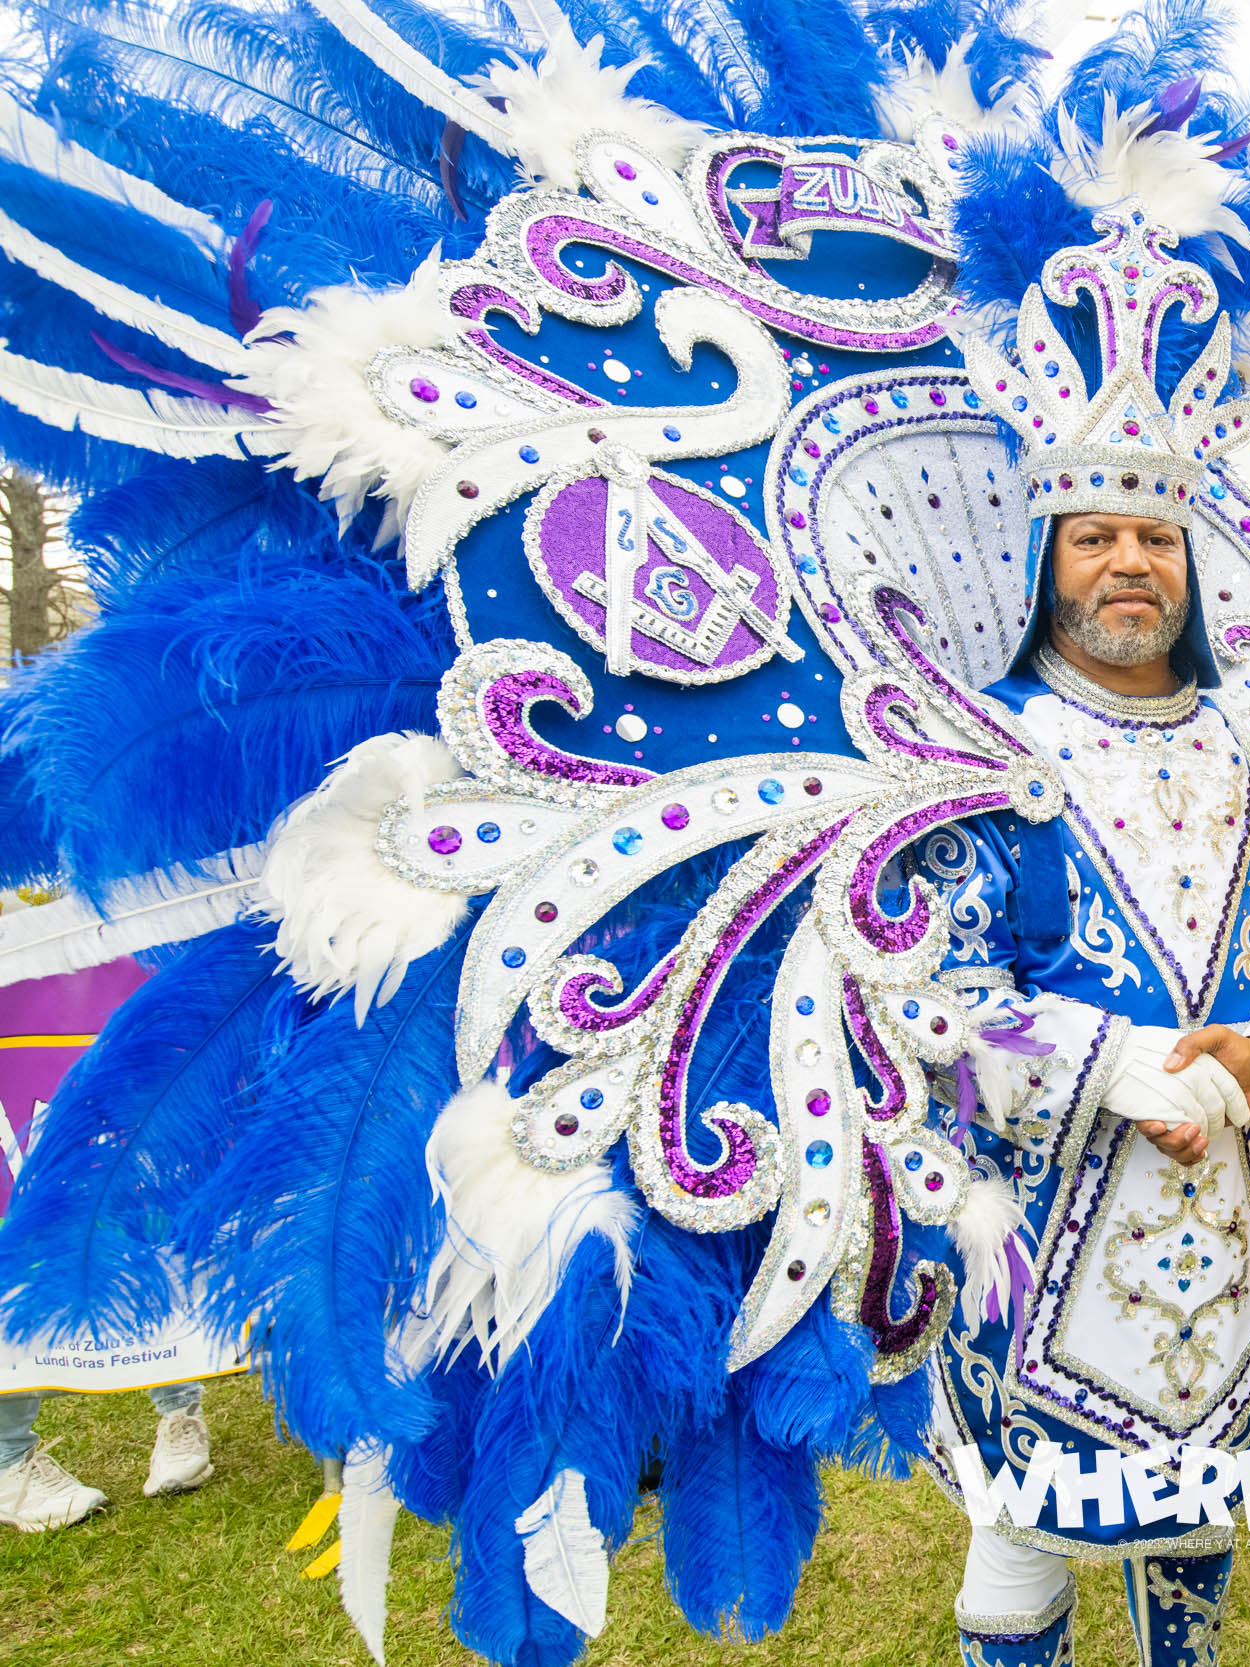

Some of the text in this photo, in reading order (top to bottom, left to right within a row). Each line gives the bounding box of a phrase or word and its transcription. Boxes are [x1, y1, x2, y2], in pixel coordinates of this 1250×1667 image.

[792, 165, 904, 227] ZULU
[35, 1345, 177, 1369] Lundi Gras Festival
